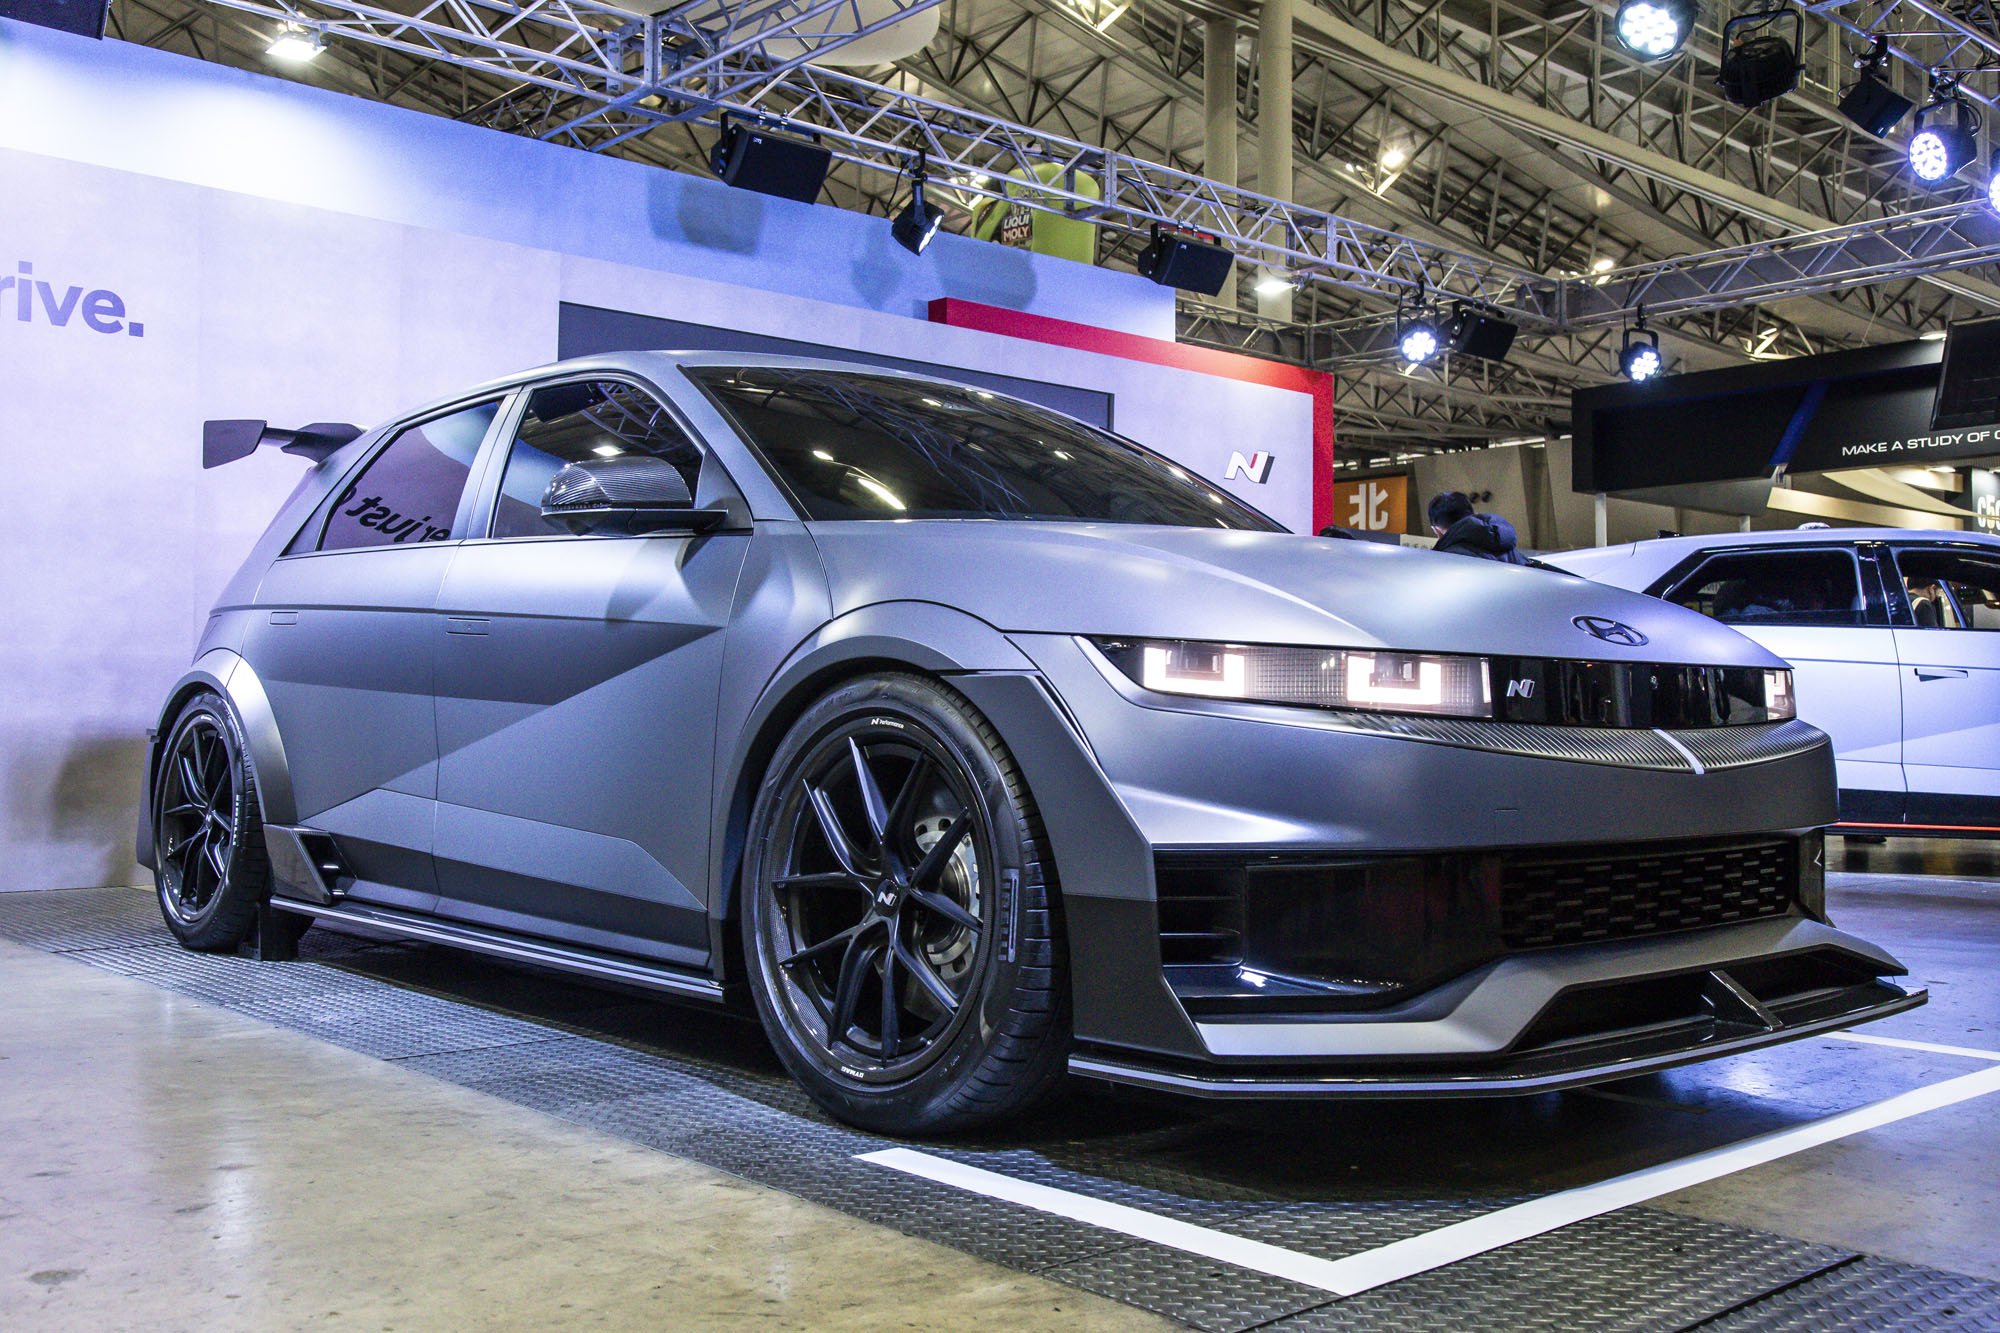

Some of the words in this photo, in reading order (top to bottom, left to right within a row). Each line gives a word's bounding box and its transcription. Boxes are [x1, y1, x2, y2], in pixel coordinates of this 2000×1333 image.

[1003, 213, 1030, 228] LIQUI
[1003, 226, 1030, 242] MOLY
[1842, 442, 1887, 456] MAKE
[1891, 441, 1903, 450] A
[1907, 433, 1963, 449] STUDY
[1967, 430, 1991, 442] OF
[1349, 482, 1388, 530] 北
